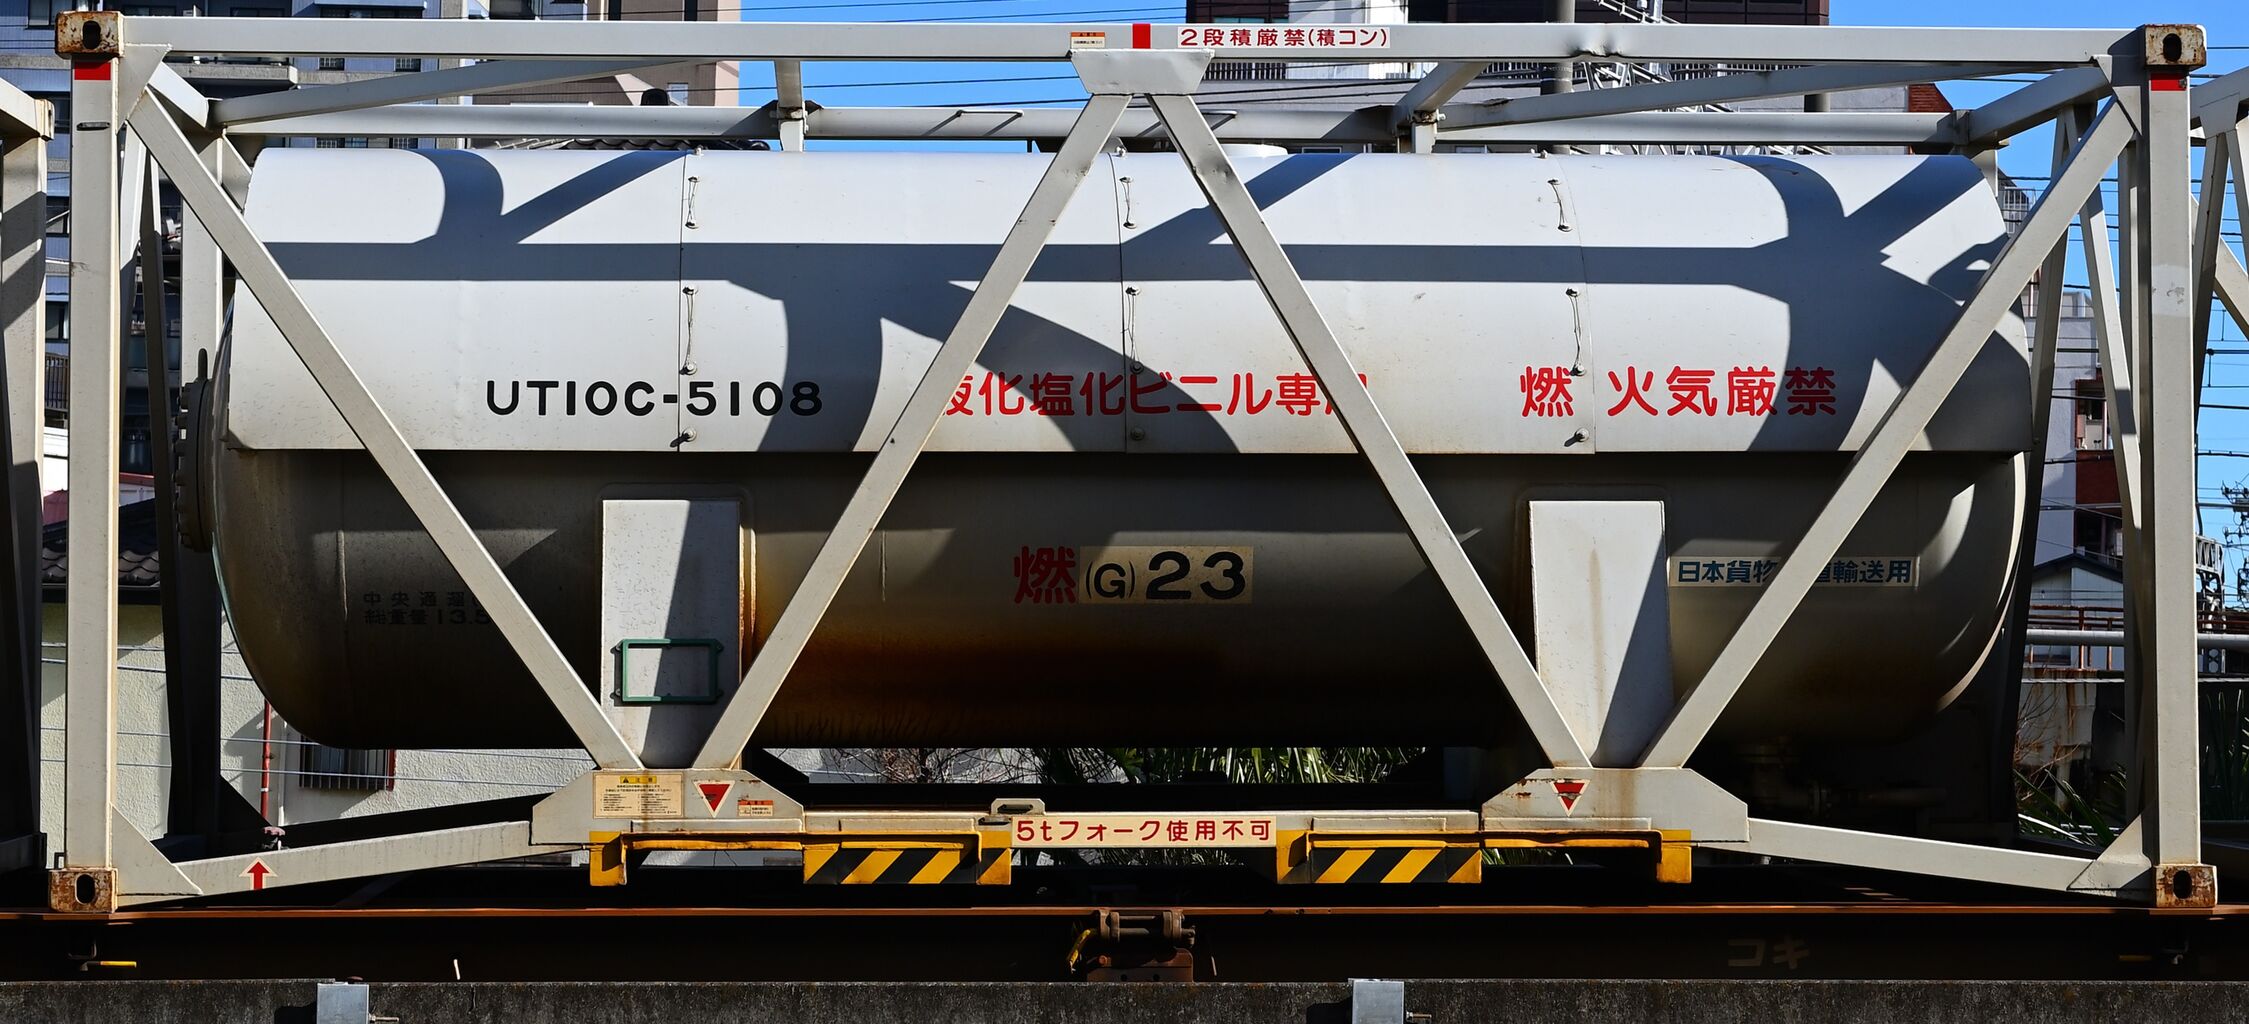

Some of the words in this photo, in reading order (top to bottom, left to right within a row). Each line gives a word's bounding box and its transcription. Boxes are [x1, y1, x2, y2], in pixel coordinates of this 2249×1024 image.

[1180, 28, 1388, 47] 2段積厳禁(積コン)
[486, 380, 823, 417] UT10C-5108
[944, 370, 1367, 417] 化塩化ビニル専
[1519, 365, 1574, 418] 燃
[1607, 365, 1837, 417] 火気厳禁
[1016, 820, 1272, 842] 5tフォーク使用不可
[1727, 935, 1811, 971] コキ
